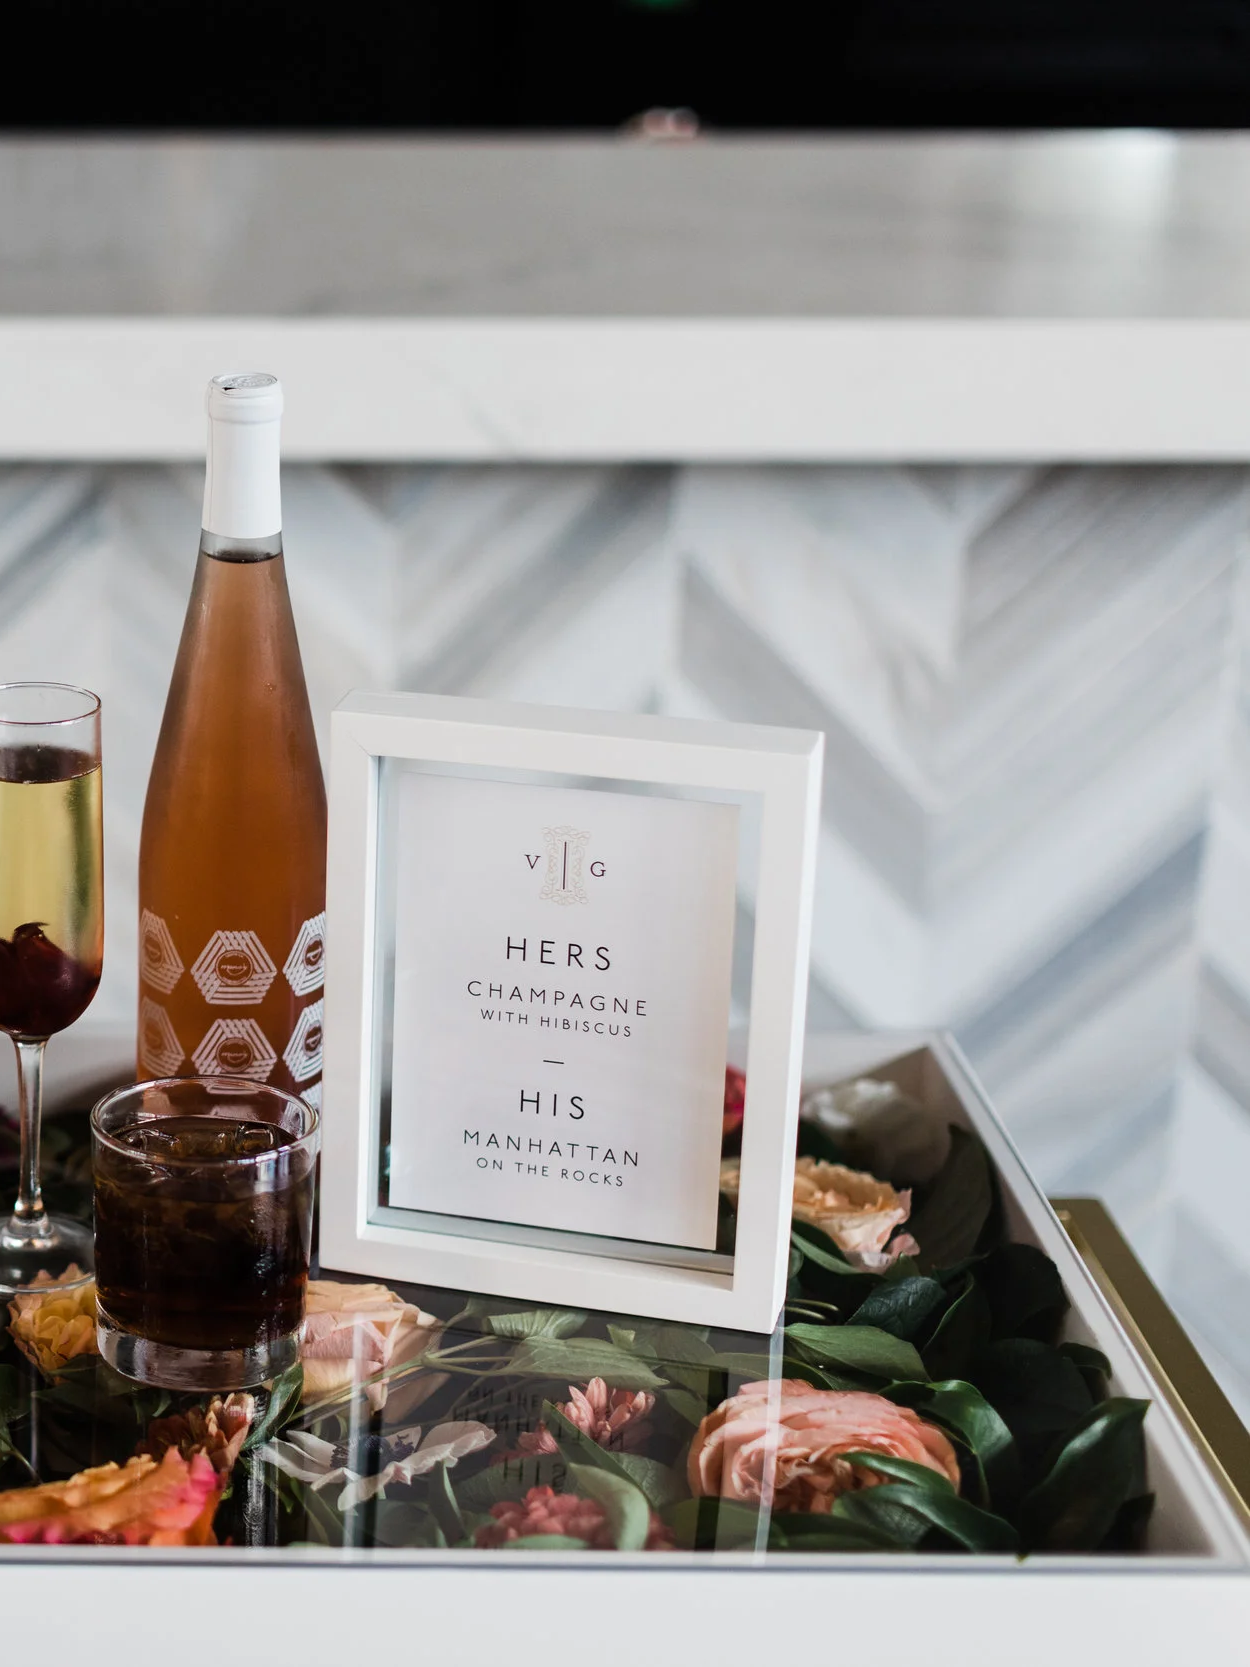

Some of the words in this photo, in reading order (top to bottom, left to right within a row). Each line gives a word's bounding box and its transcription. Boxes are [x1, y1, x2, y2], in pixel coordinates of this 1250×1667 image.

[524, 854, 541, 869] V
[590, 861, 606, 877] G
[507, 936, 611, 972] HERS
[467, 981, 647, 1017] CHAMPAGNE
[480, 1009, 529, 1025] WITH
[540, 1015, 631, 1038] HIBISCUS
[519, 1090, 585, 1121] HIS
[463, 1130, 639, 1167] MANHATTAN
[476, 1157, 503, 1171] ON
[514, 1161, 549, 1178] THE
[560, 1168, 623, 1188] ROCKS
